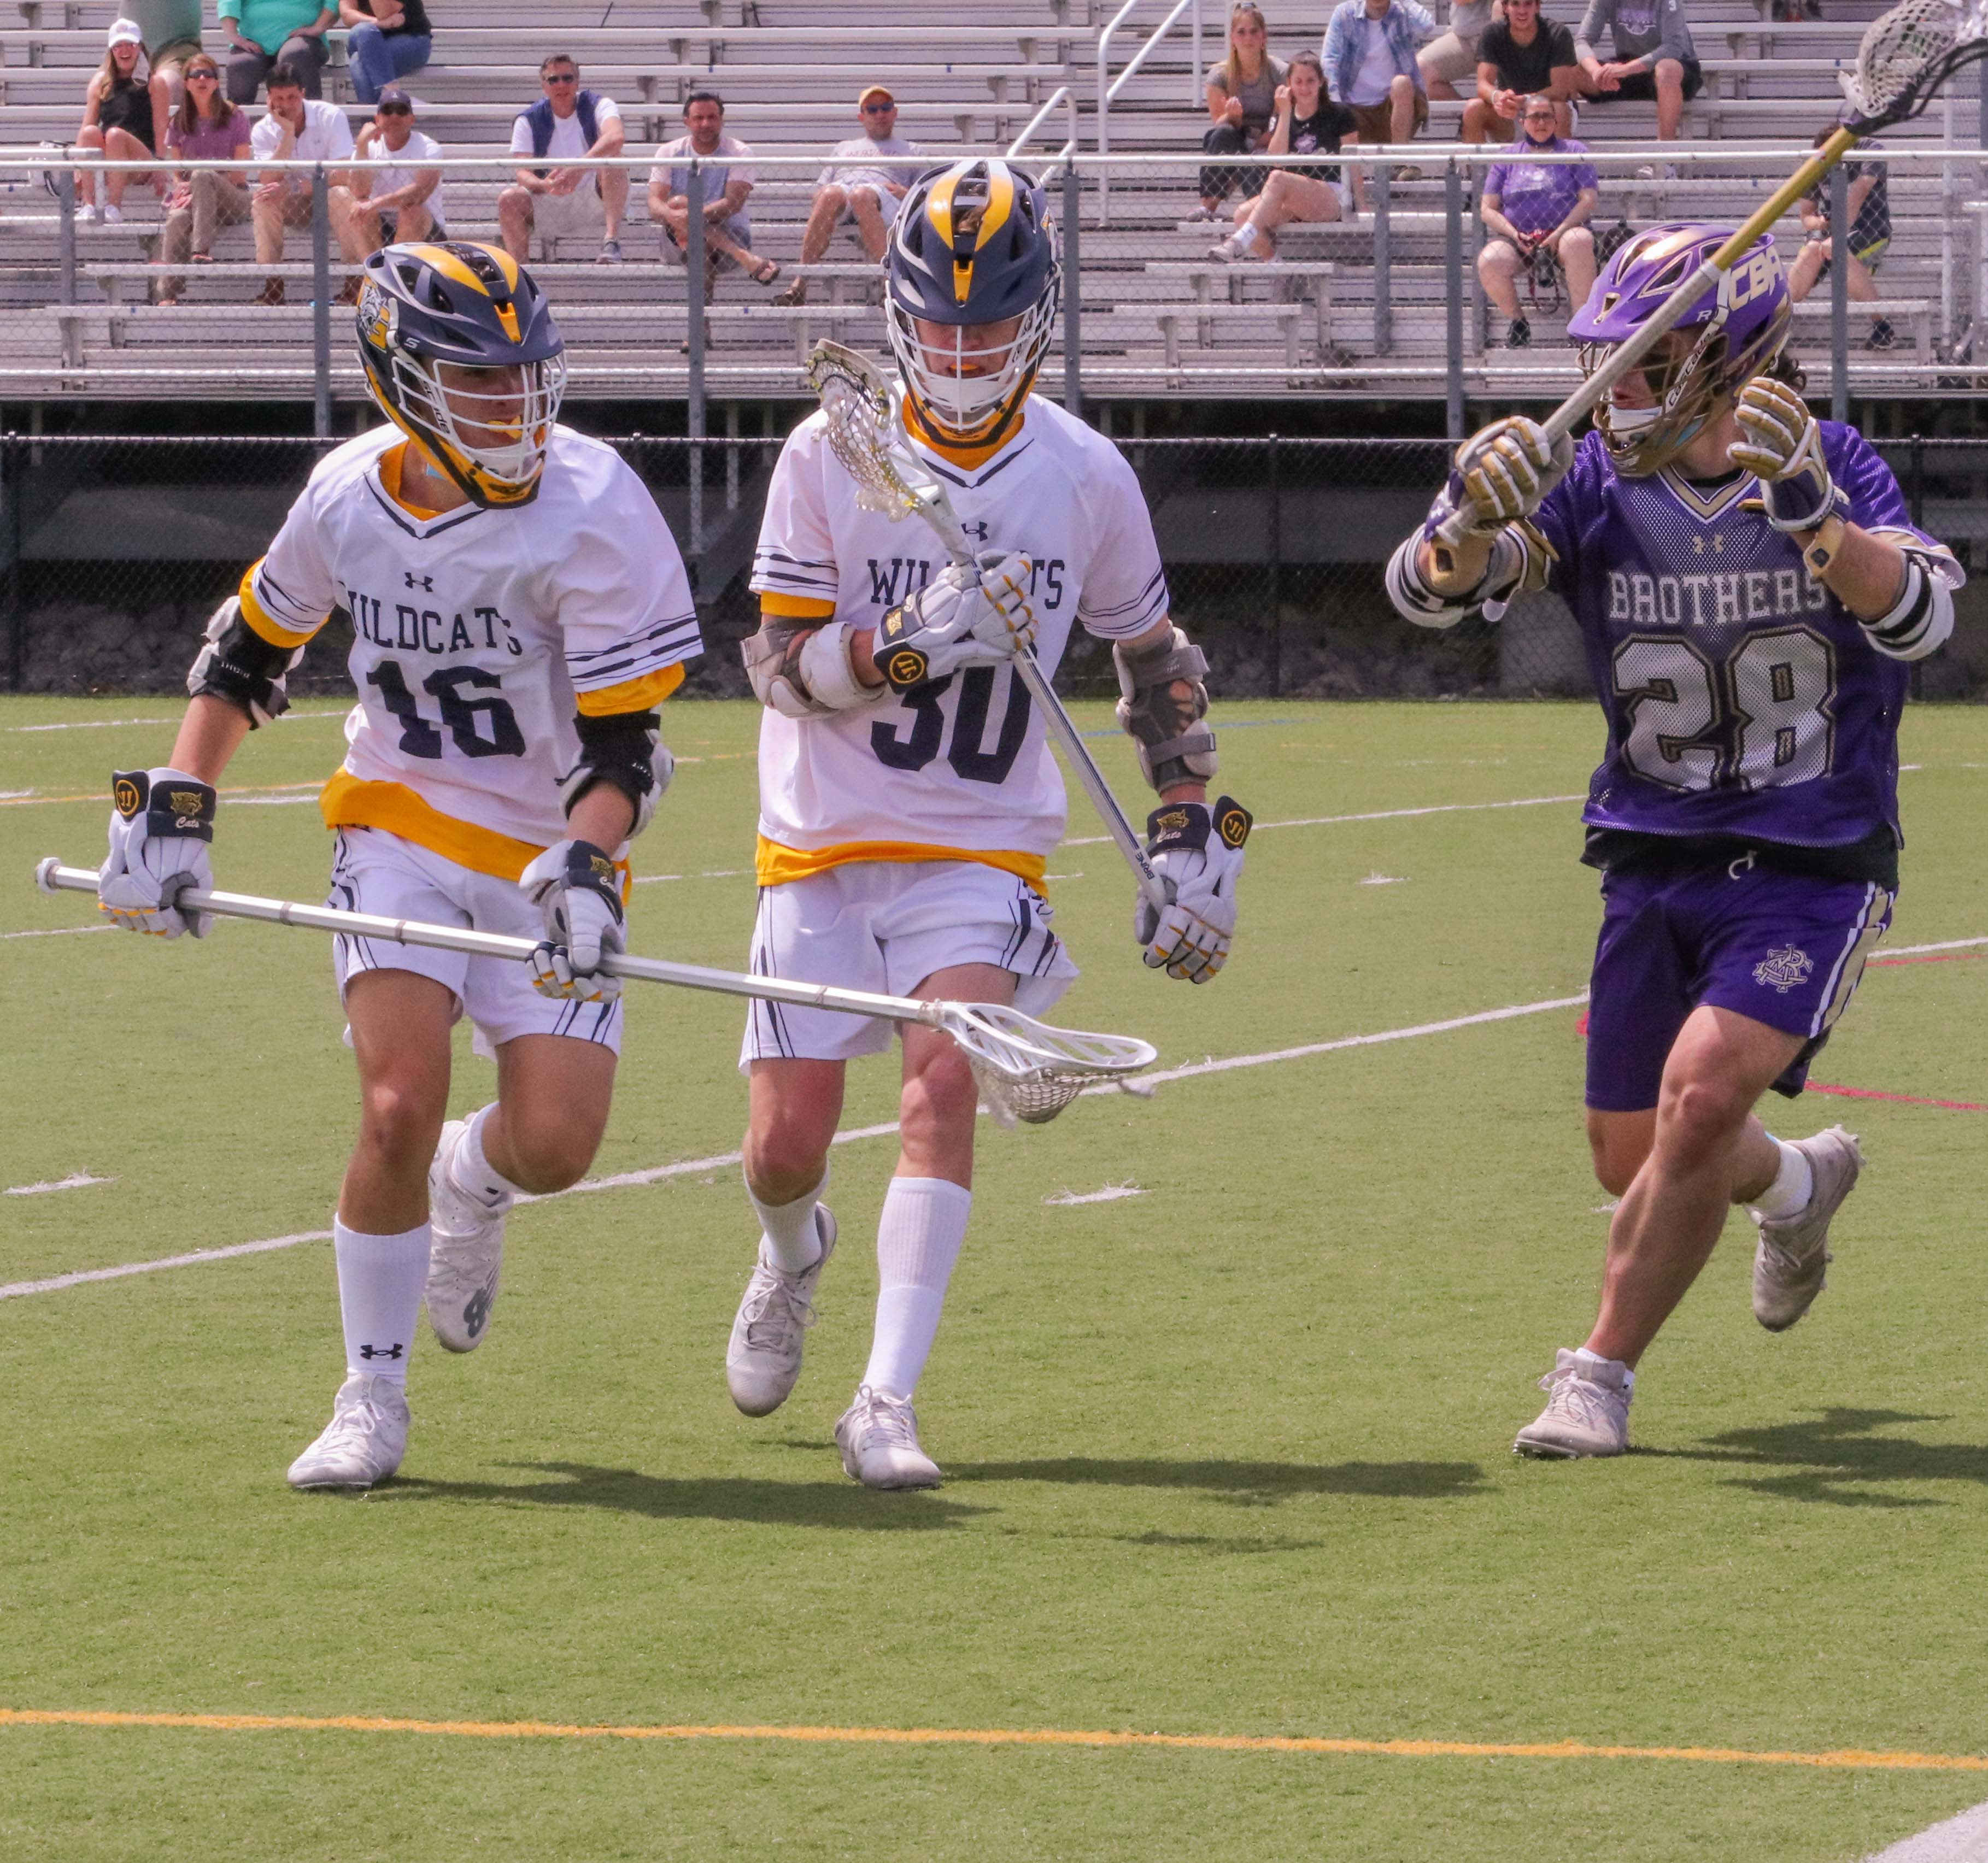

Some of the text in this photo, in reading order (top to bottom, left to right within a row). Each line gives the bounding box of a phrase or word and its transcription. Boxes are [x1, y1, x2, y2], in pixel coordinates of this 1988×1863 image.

[1728, 244, 1783, 312] CBA
[1696, 309, 1712, 322] R
[1608, 568, 1826, 625] BROTHERS
[366, 661, 526, 759] 16
[870, 666, 1032, 784] 30
[1612, 623, 1837, 792] 28
[1135, 851, 1155, 880] BRINE
